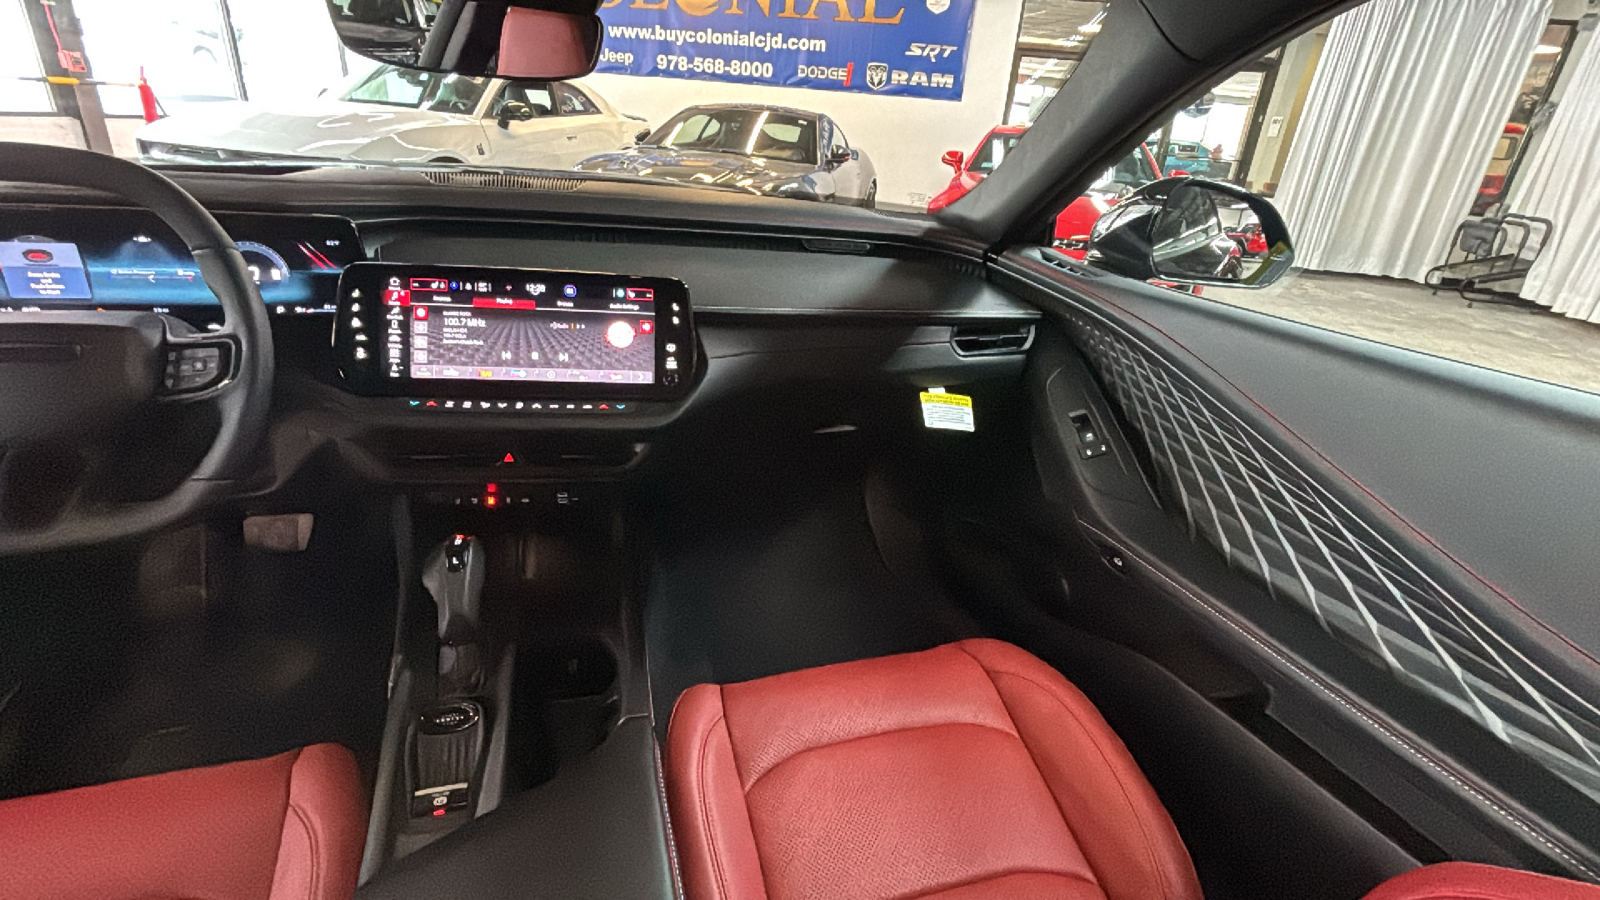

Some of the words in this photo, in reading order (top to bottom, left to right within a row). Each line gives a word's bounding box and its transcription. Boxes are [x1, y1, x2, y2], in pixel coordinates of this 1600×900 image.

[608, 25, 826, 52] www.buycolonialcjd.com
[600, 48, 634, 66] Jeep
[905, 43, 958, 62] SRT
[656, 54, 774, 78] 978-568-8000
[797, 64, 848, 81] DODGE
[891, 69, 954, 88] RAM
[444, 317, 466, 326] 100.7
